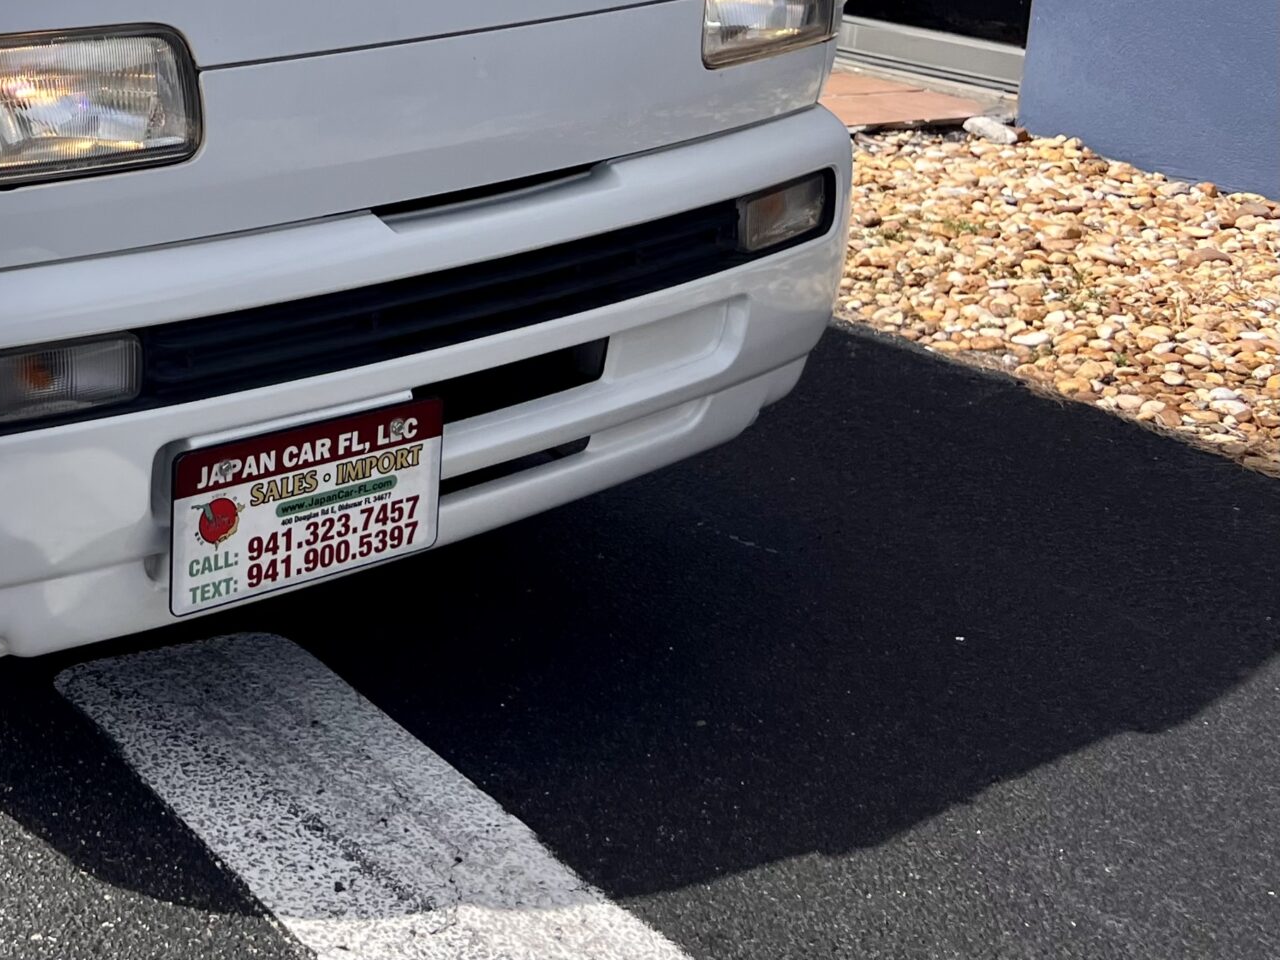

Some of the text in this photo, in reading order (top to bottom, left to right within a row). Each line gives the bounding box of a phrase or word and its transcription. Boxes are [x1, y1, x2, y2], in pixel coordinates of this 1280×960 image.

[196, 449, 277, 490] JAPAN
[282, 438, 332, 468] CAR
[337, 430, 371, 456] FL,
[250, 444, 424, 507] SALES IMPORT
[280, 478, 393, 514] www.JapanCar-FL.com
[188, 551, 239, 578] CALL:
[247, 494, 420, 562] 941.323.7457
[188, 576, 238, 605] TEXT:
[247, 521, 419, 589] 941.900.5397
